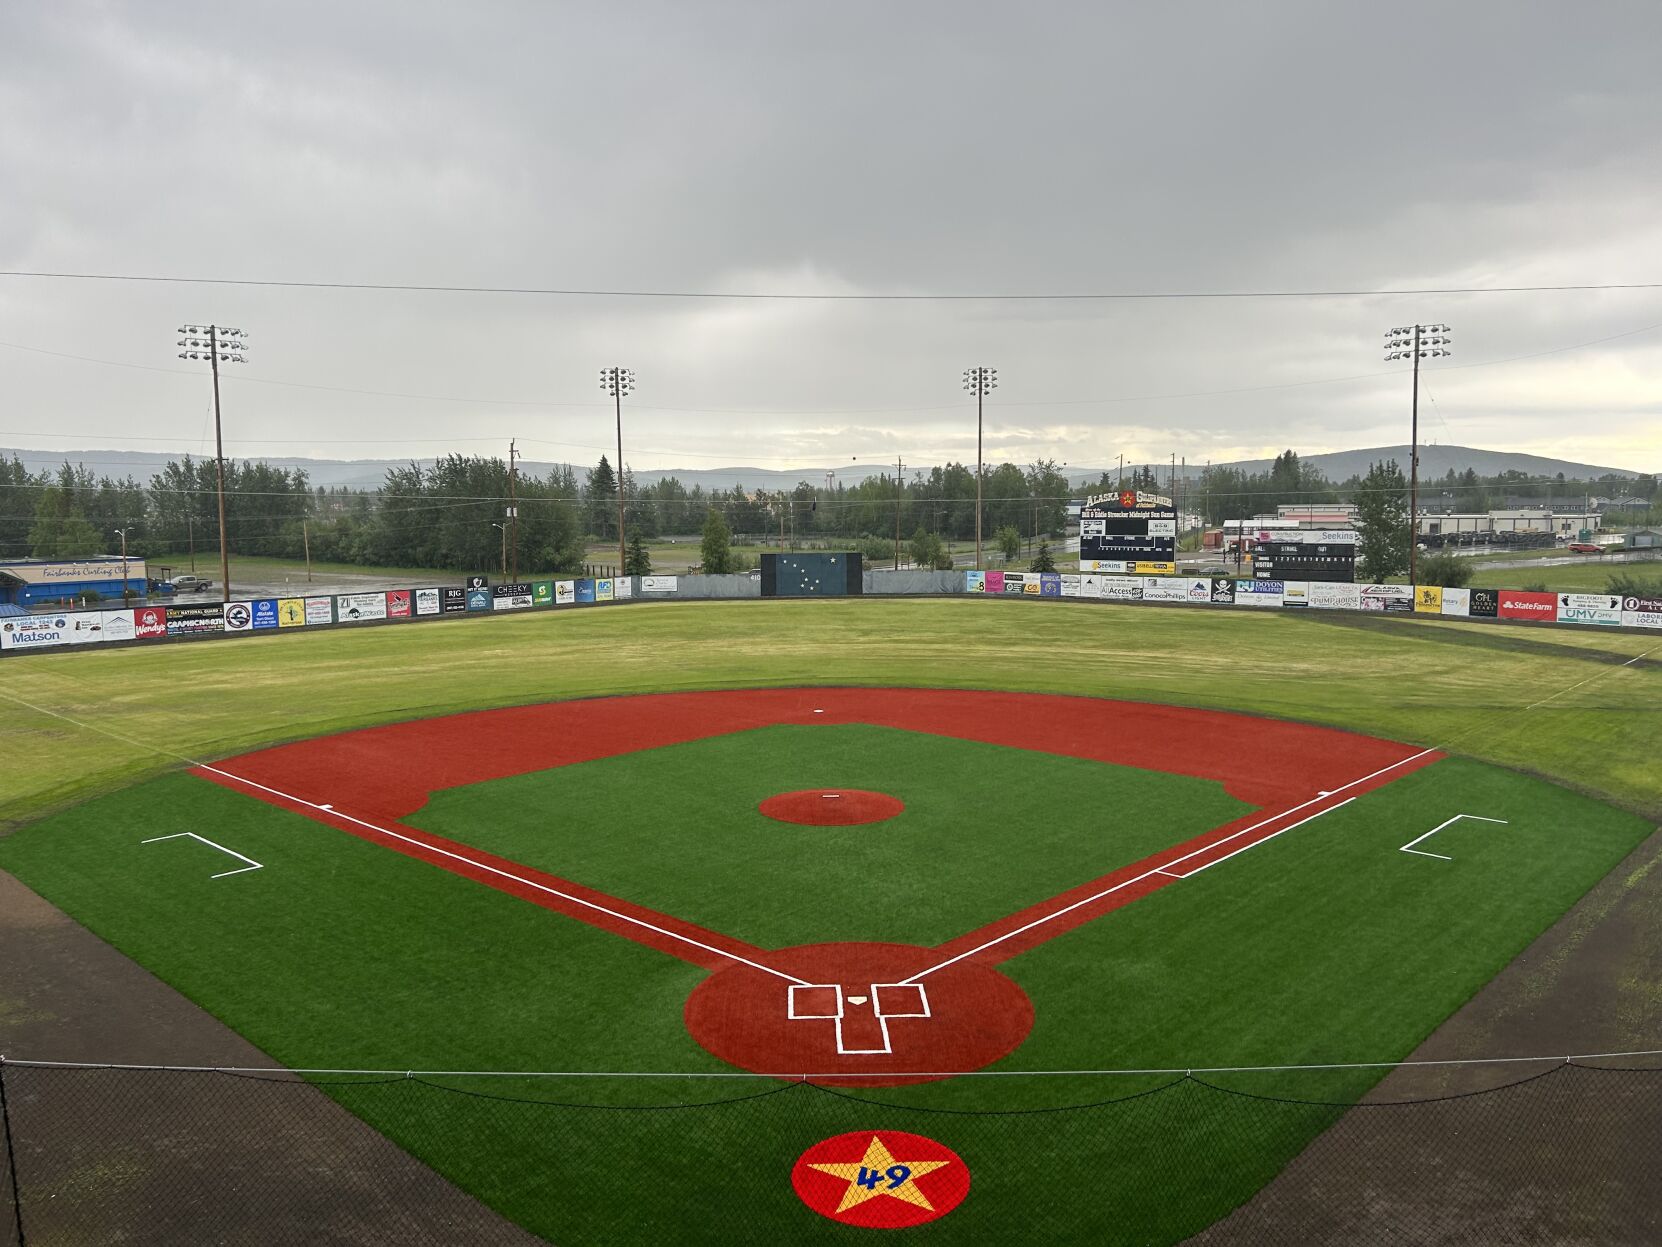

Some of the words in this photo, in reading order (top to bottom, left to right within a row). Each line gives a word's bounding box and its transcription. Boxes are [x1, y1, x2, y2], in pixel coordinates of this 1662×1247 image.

[1085, 492, 1120, 508] ALASKA
[1129, 511, 1150, 519] Midnight
[1322, 531, 1354, 540] Seekins
[1097, 561, 1121, 569] Seekins
[43, 567, 81, 577] Fairbanks
[82, 566, 112, 577] Curling
[497, 585, 528, 594] CHEEKY
[1189, 589, 1209, 597] Coors
[1144, 592, 1186, 600] ConocoPhillips
[135, 622, 166, 636] Wendy's
[12, 631, 60, 643] Matson
[856, 1164, 912, 1190] 49
